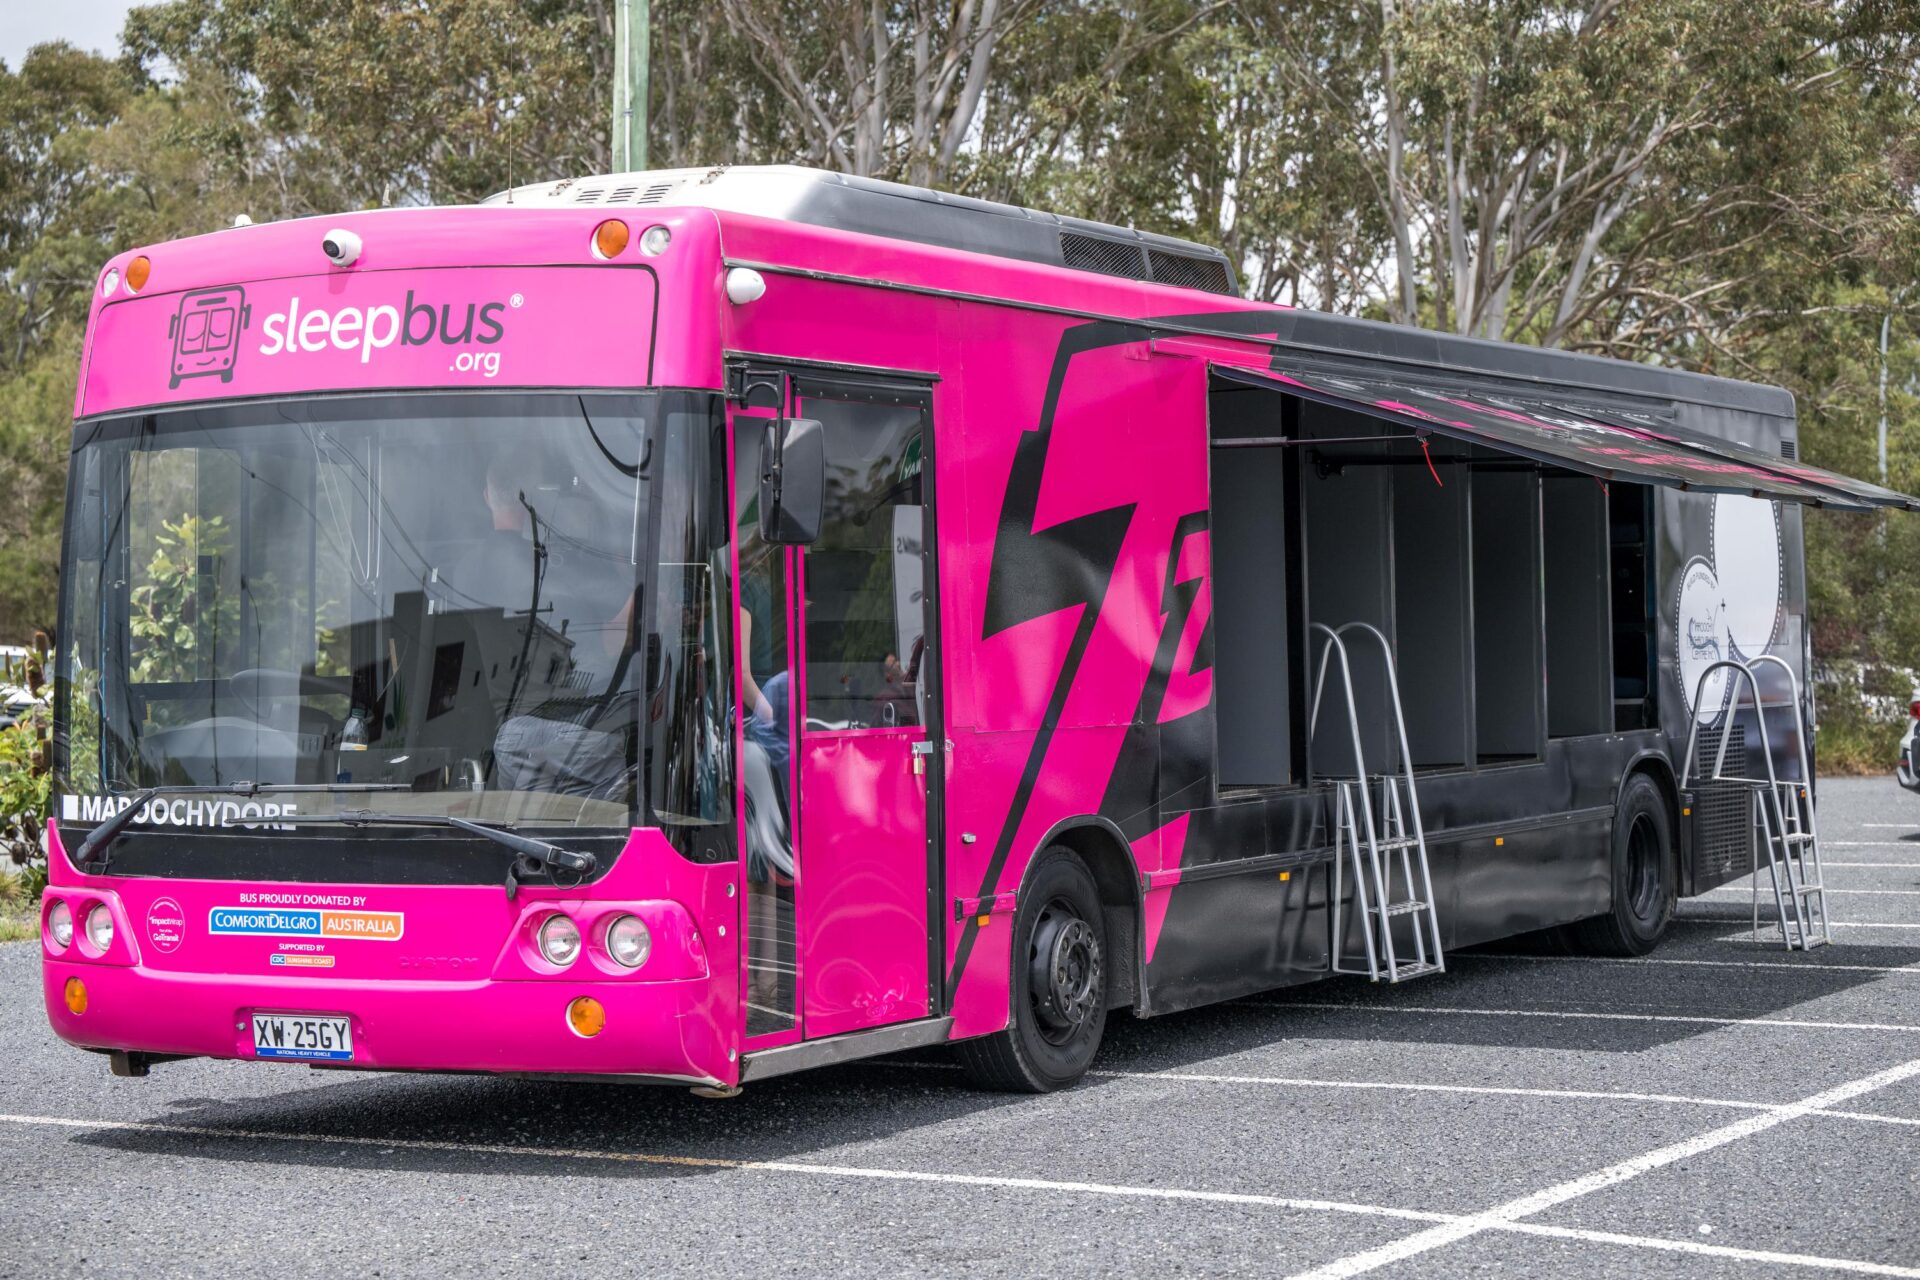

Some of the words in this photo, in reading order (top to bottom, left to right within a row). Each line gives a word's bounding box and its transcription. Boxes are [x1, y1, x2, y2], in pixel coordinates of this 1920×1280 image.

[449, 352, 500, 377] .org
[239, 893, 257, 903] BUS
[259, 893, 302, 904] PROUDLY
[303, 894, 351, 906] DONATED
[353, 896, 367, 907] BY
[326, 918, 395, 933] AUSTRALIA
[278, 943, 316, 951] SUPPORTED
[316, 944, 325, 952] BY
